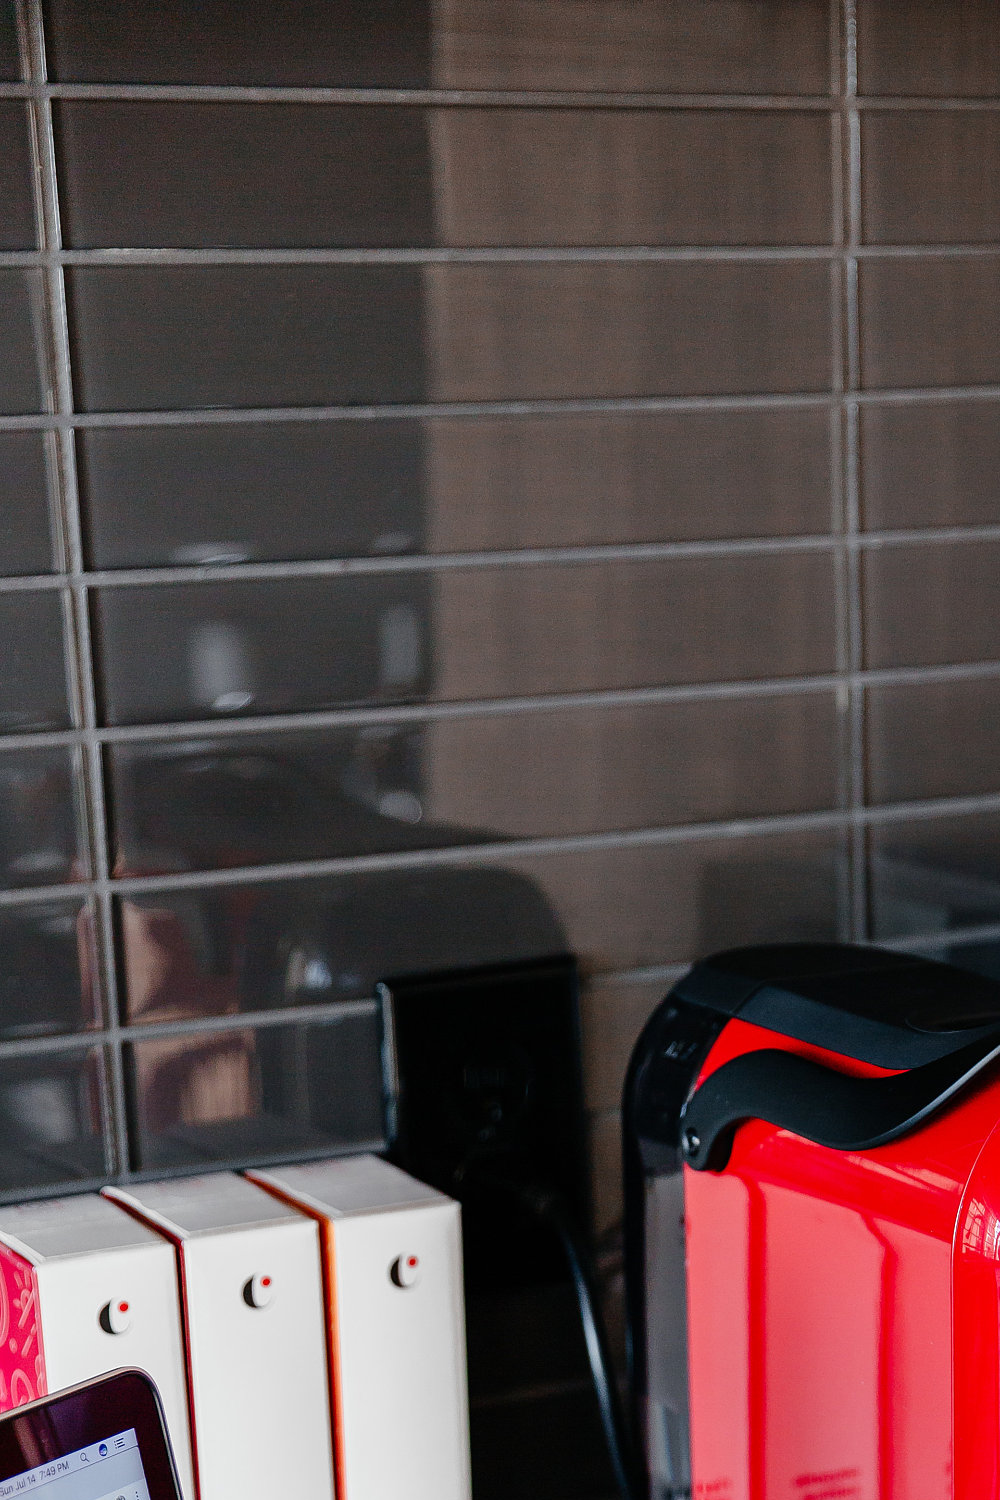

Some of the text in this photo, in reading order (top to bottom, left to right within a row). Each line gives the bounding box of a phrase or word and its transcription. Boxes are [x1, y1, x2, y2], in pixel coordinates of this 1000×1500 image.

[15, 1479, 27, 1491] Jul
[27, 1475, 36, 1485] 14
[39, 1466, 56, 1480] 7:49
[57, 1461, 70, 1473] PM
